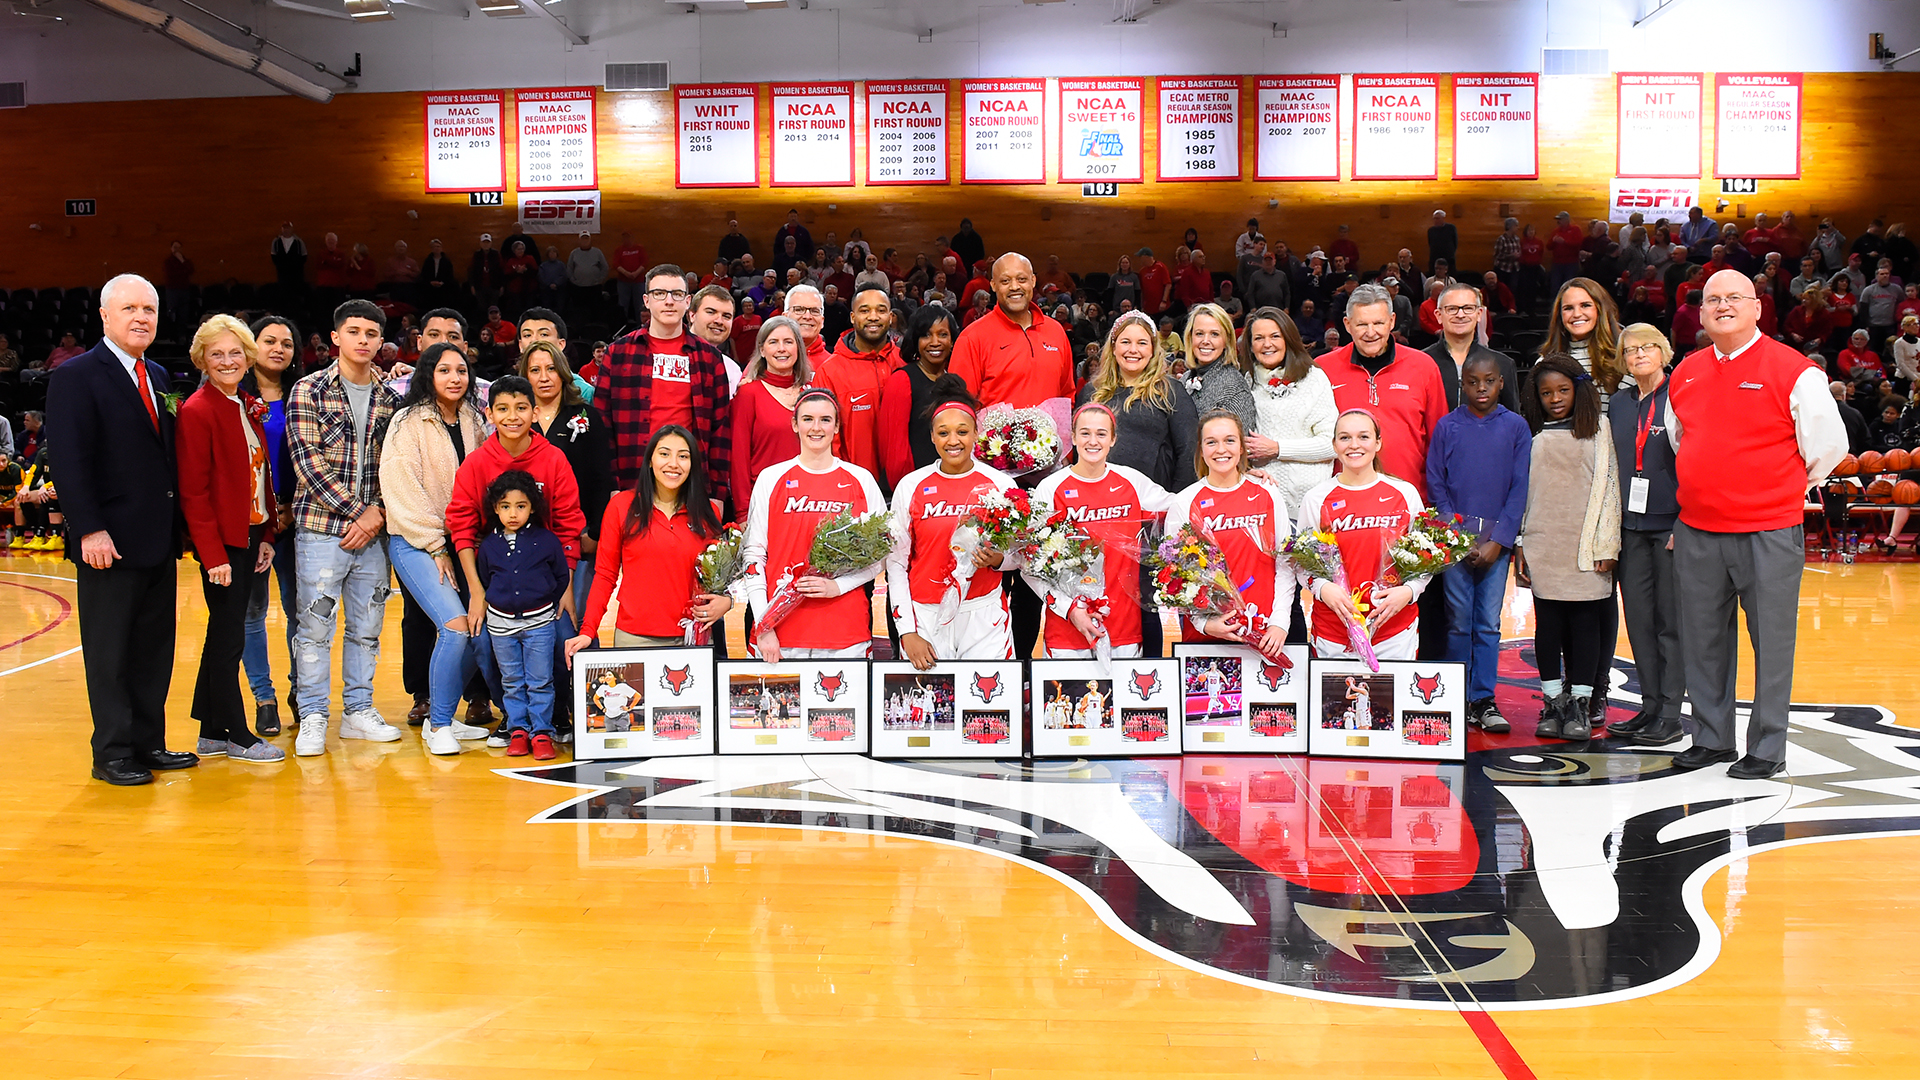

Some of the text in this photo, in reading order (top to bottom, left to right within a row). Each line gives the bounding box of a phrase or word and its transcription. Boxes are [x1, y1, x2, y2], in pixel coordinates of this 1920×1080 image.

[1648, 76, 1699, 84] BASKETBALL
[1728, 76, 1790, 84] VOLLEYBALL
[965, 83, 998, 91] WOMEN'S
[1062, 82, 1140, 90] WOMEN'S BASKETBALL
[552, 90, 592, 99] BASKETBALL
[1170, 92, 1229, 102] ECAC METRO
[1280, 92, 1315, 101] MAAC
[1646, 93, 1675, 104] NIT
[1077, 98, 1126, 110] NCAA
[1372, 95, 1421, 107] NCAA
[1480, 94, 1511, 106] NIT
[539, 104, 571, 113] MAAC
[695, 105, 738, 117] WNIT
[788, 104, 836, 116] NCAA
[883, 101, 932, 114] NCAA
[979, 100, 1028, 113] NCAA
[448, 108, 480, 116] MAAC
[1068, 112, 1136, 122] SWEET 16
[1362, 111, 1431, 122] FIRST ROUND
[1460, 111, 1531, 122] SECOND ROUND
[1626, 110, 1694, 120] FIRST ROUND
[1726, 110, 1792, 120] CHAMPIONS
[874, 118, 942, 128] FIRST ROUND
[969, 116, 1039, 126] SECOND ROUND
[1166, 112, 1233, 124] CHAMPIONS
[1264, 112, 1331, 124] CHAMPIONS
[524, 123, 587, 135] CHAMPIONS
[684, 120, 750, 131] FIRST ROUND
[779, 119, 846, 130] FIRST ROUND
[433, 125, 495, 138] CHAMPIONS
[1185, 130, 1215, 139] 1985
[438, 140, 490, 149] 2012 2013
[529, 138, 583, 147] 2004 2005
[562, 150, 583, 158] 2007
[1185, 145, 1215, 154] 1987
[438, 153, 459, 161] 2014
[530, 161, 583, 170] 2008 2009
[1086, 164, 1116, 174] 2007
[1185, 160, 1216, 170] 1988
[879, 168, 936, 176] 2011 2012
[530, 173, 583, 182] 2010 2011
[1090, 183, 1113, 194] 103
[1726, 179, 1752, 192] 104
[474, 193, 497, 204] 102
[1617, 188, 1692, 207] ESPN
[72, 202, 90, 213] 101
[524, 200, 595, 218] ESPN
[1066, 504, 1132, 522] MARIST
[1202, 514, 1267, 534] MARIST
[1332, 514, 1402, 533] MARIST
